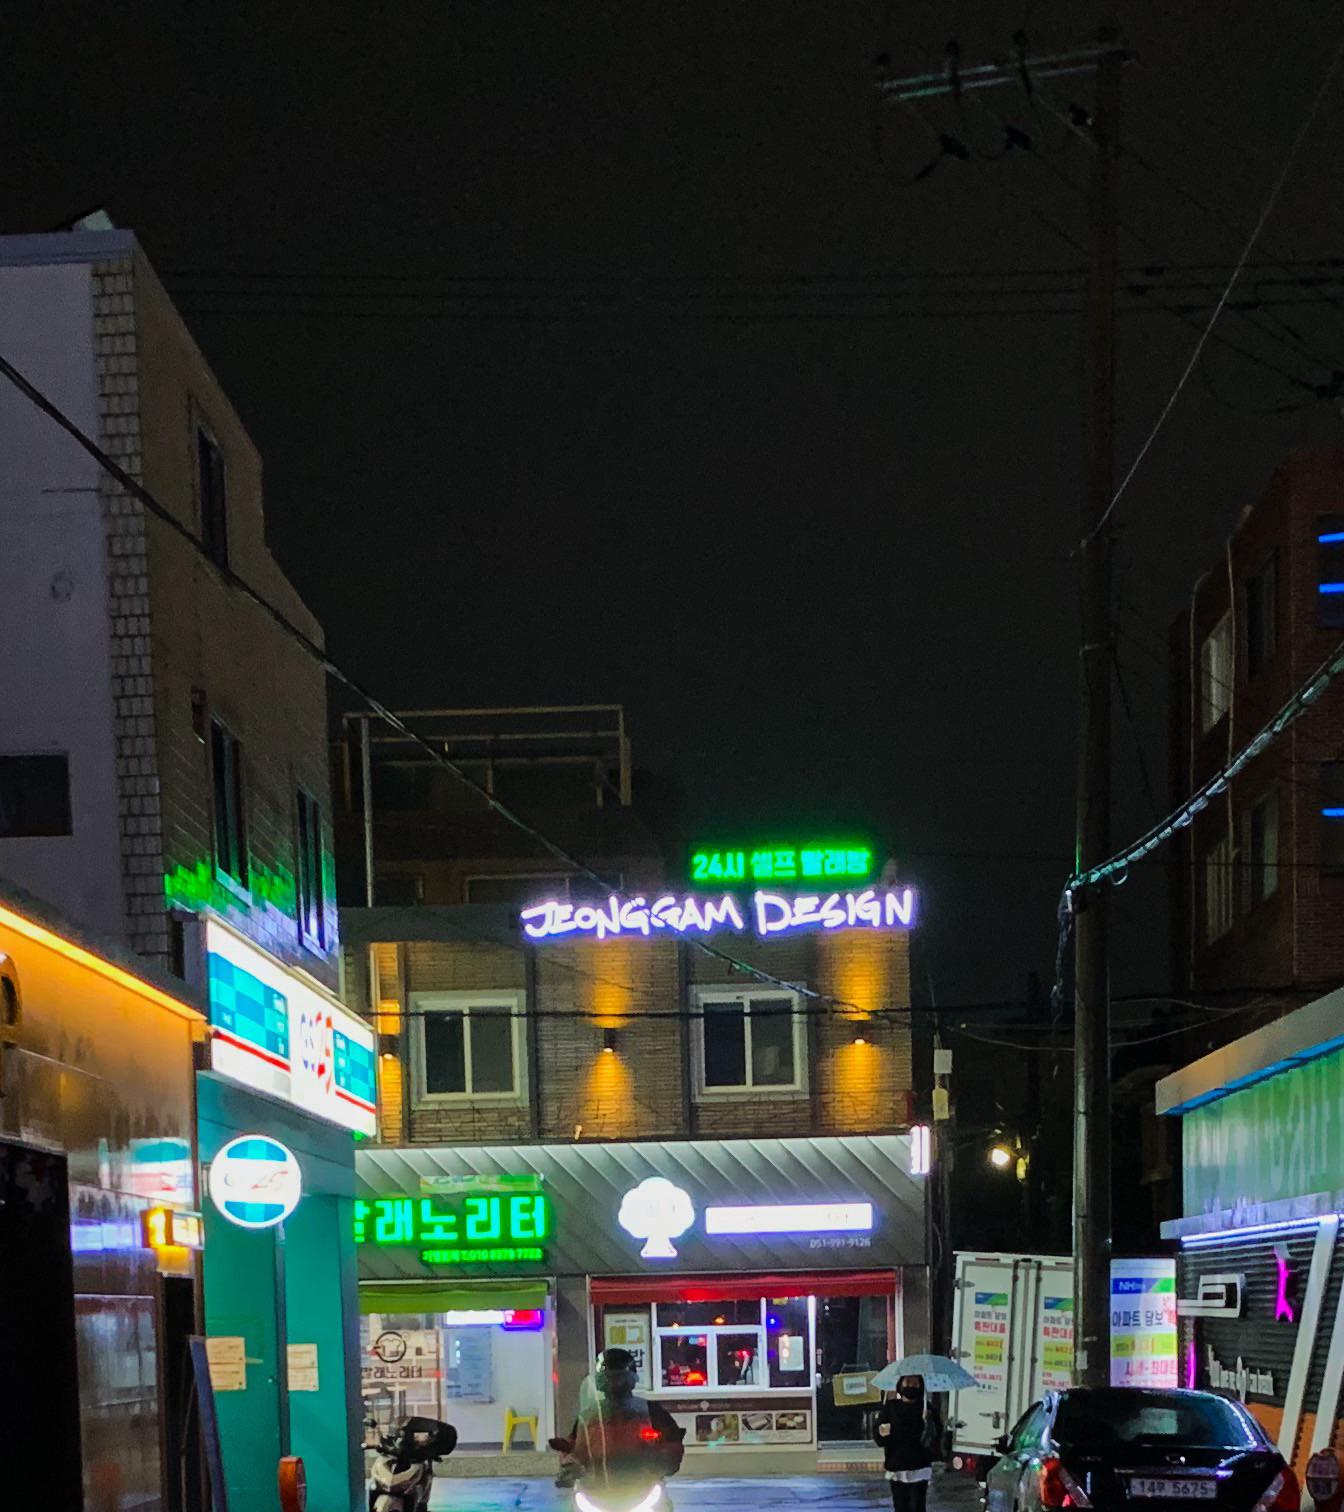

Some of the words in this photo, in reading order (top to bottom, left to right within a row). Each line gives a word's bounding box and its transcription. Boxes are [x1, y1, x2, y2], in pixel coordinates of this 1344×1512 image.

[521, 895, 745, 939] JEONGGAM
[755, 889, 913, 935] DESIGN
[1112, 1310, 1142, 1328] 아파트
